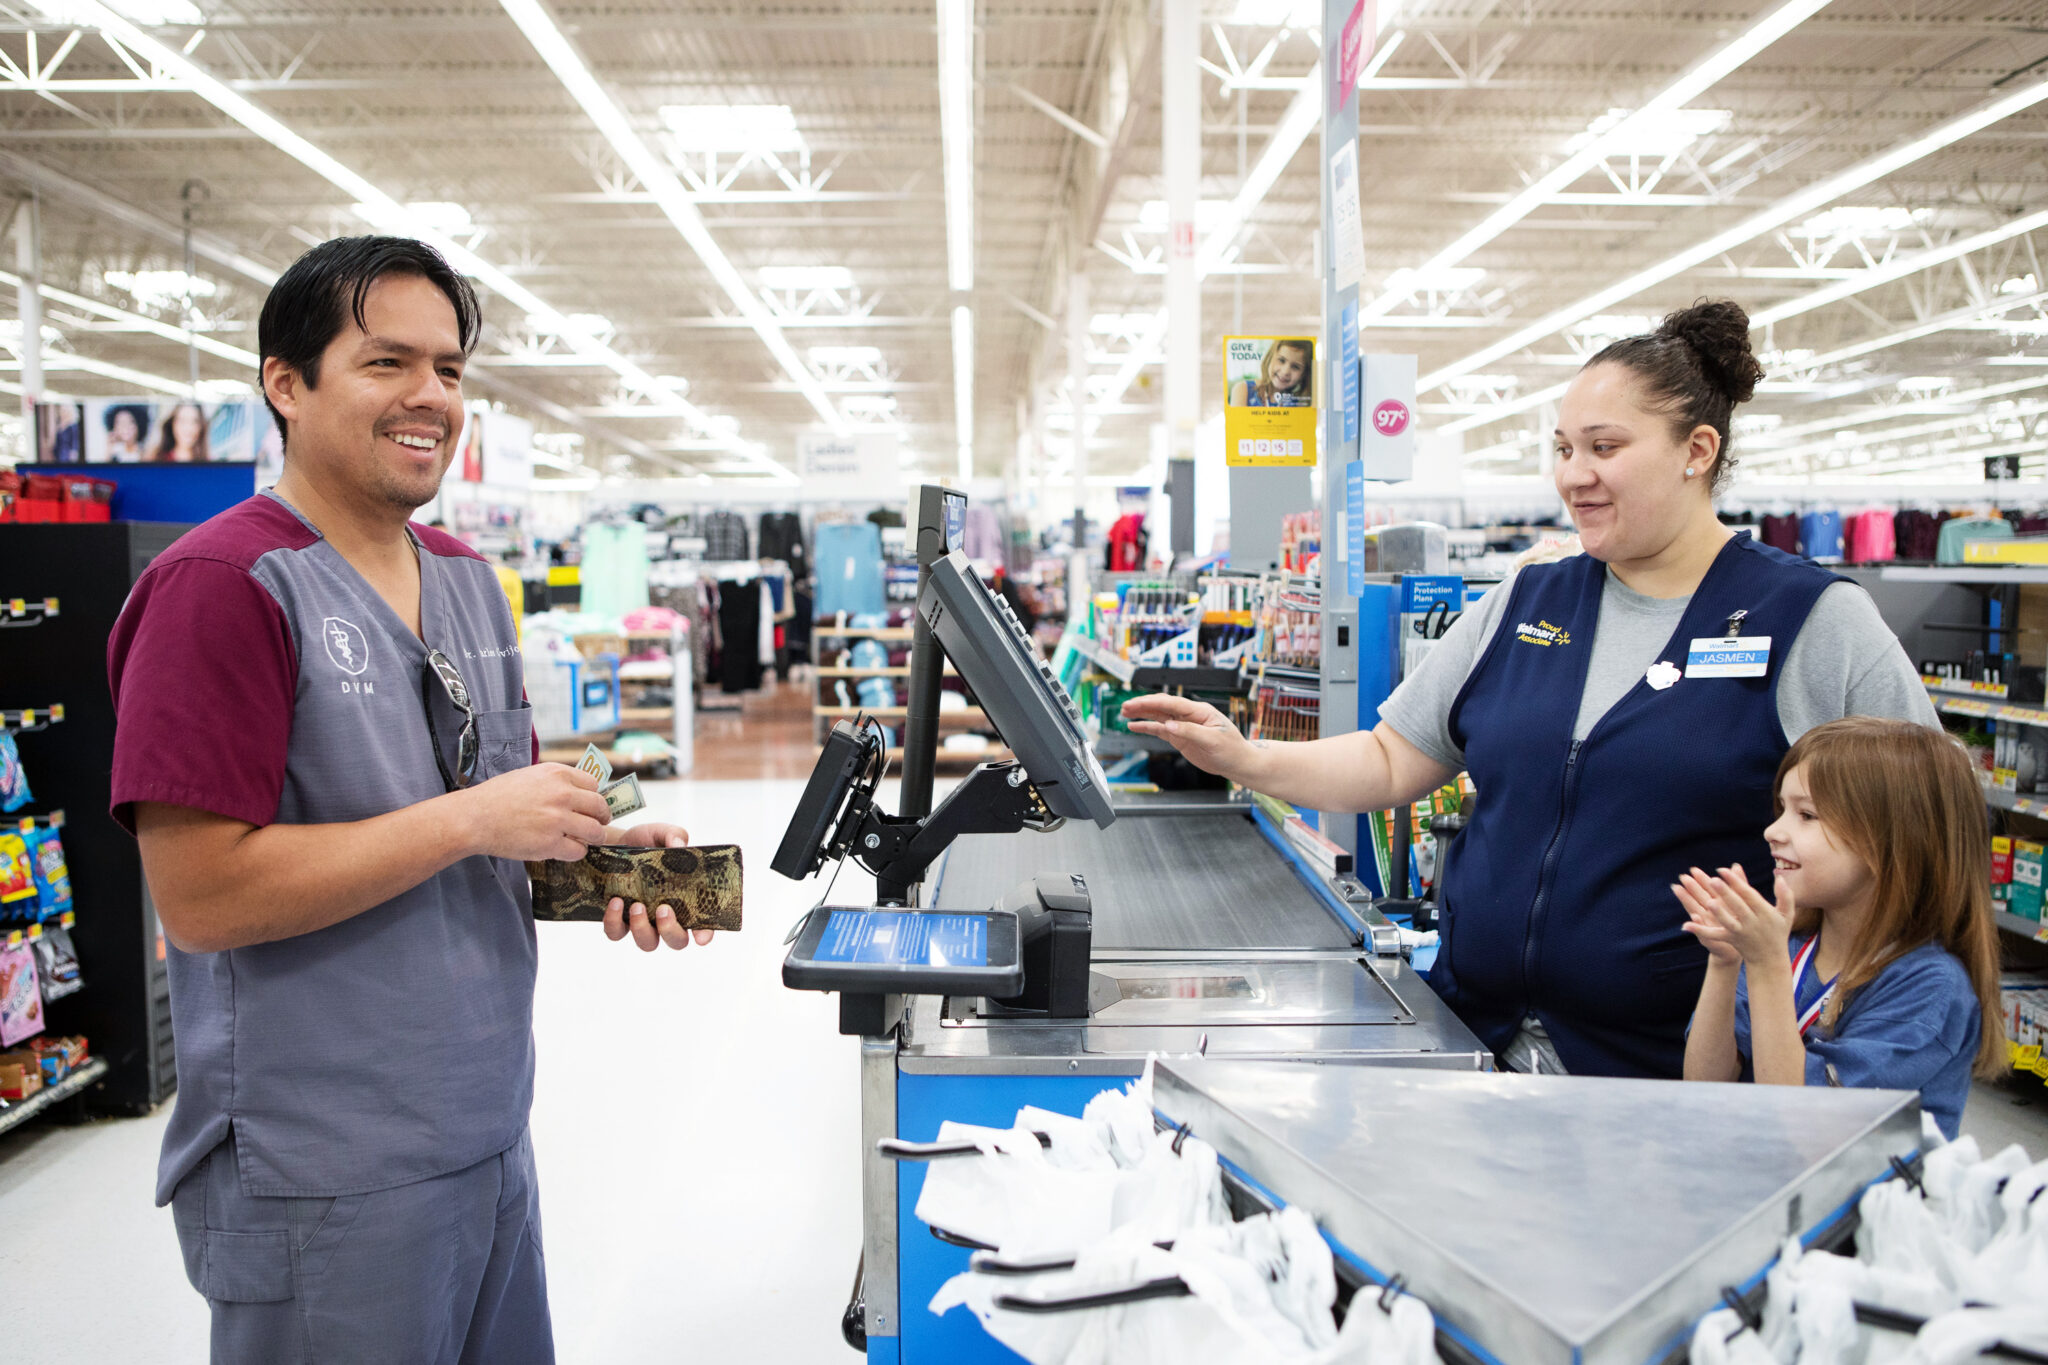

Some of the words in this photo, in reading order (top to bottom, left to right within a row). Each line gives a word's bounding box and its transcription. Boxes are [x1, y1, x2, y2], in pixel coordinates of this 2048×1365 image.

[1231, 343, 1253, 352] GIVE
[1231, 352, 1263, 361] TODAY
[1414, 586, 1453, 594] Protection
[1538, 620, 1562, 633] Proud
[1517, 633, 1552, 647] Associate
[1700, 652, 1756, 664] JASMEN
[341, 681, 374, 694] DVM
